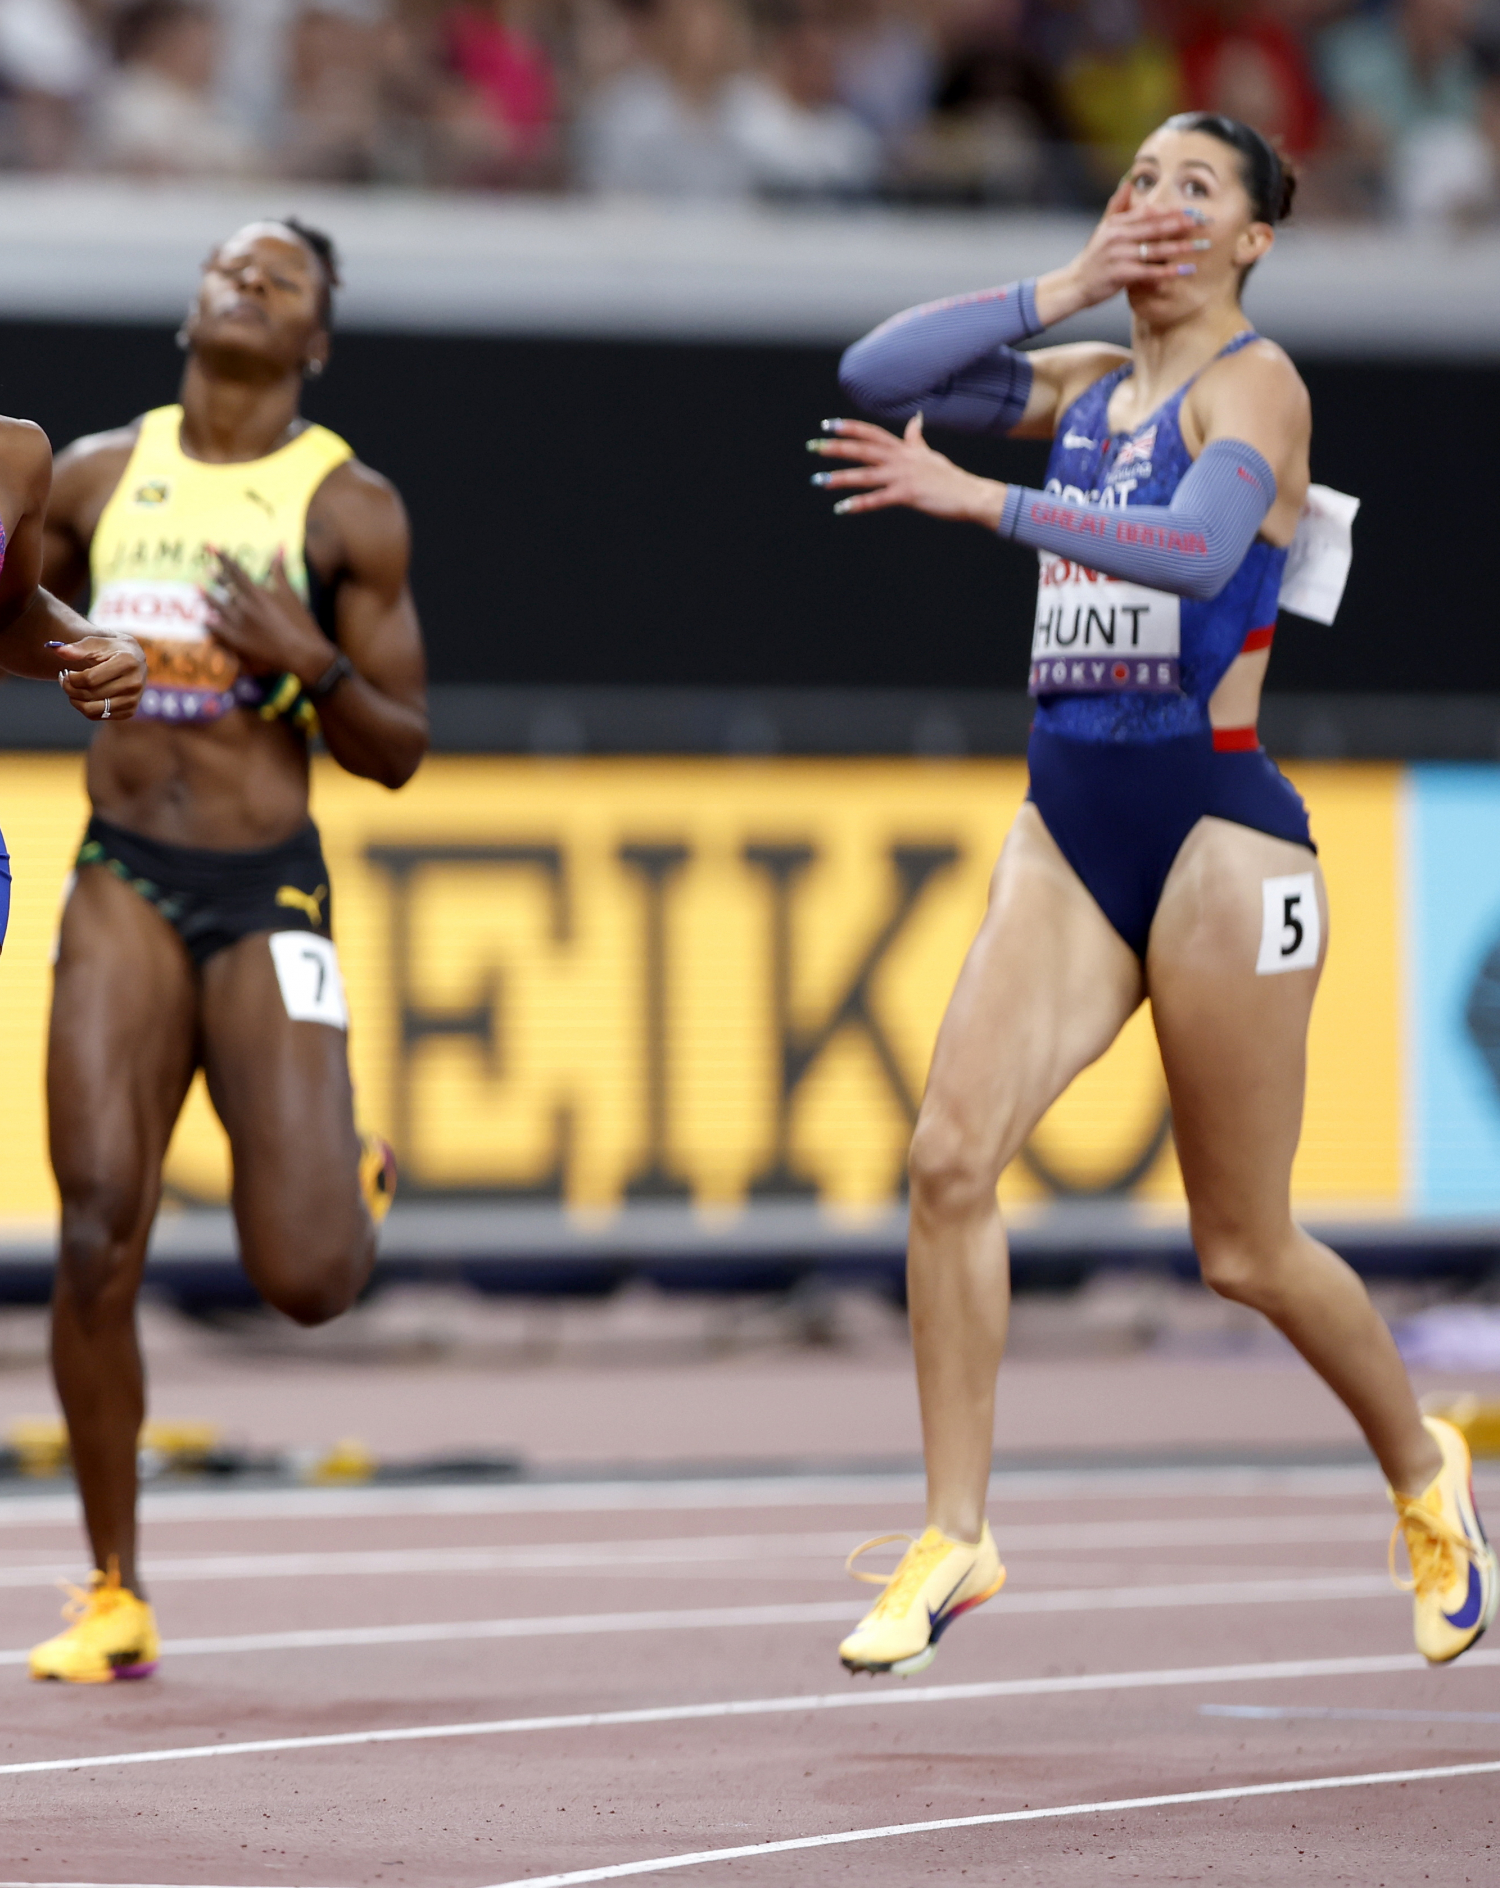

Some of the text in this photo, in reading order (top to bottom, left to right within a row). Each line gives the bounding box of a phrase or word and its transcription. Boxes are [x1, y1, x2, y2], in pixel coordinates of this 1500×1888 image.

[1031, 501, 1208, 557] GREAT BRITAIN
[1035, 605, 1150, 646] HUNT
[1281, 893, 1304, 958] 5
[301, 949, 327, 1004] 7
[160, 838, 1180, 1202] EIK
